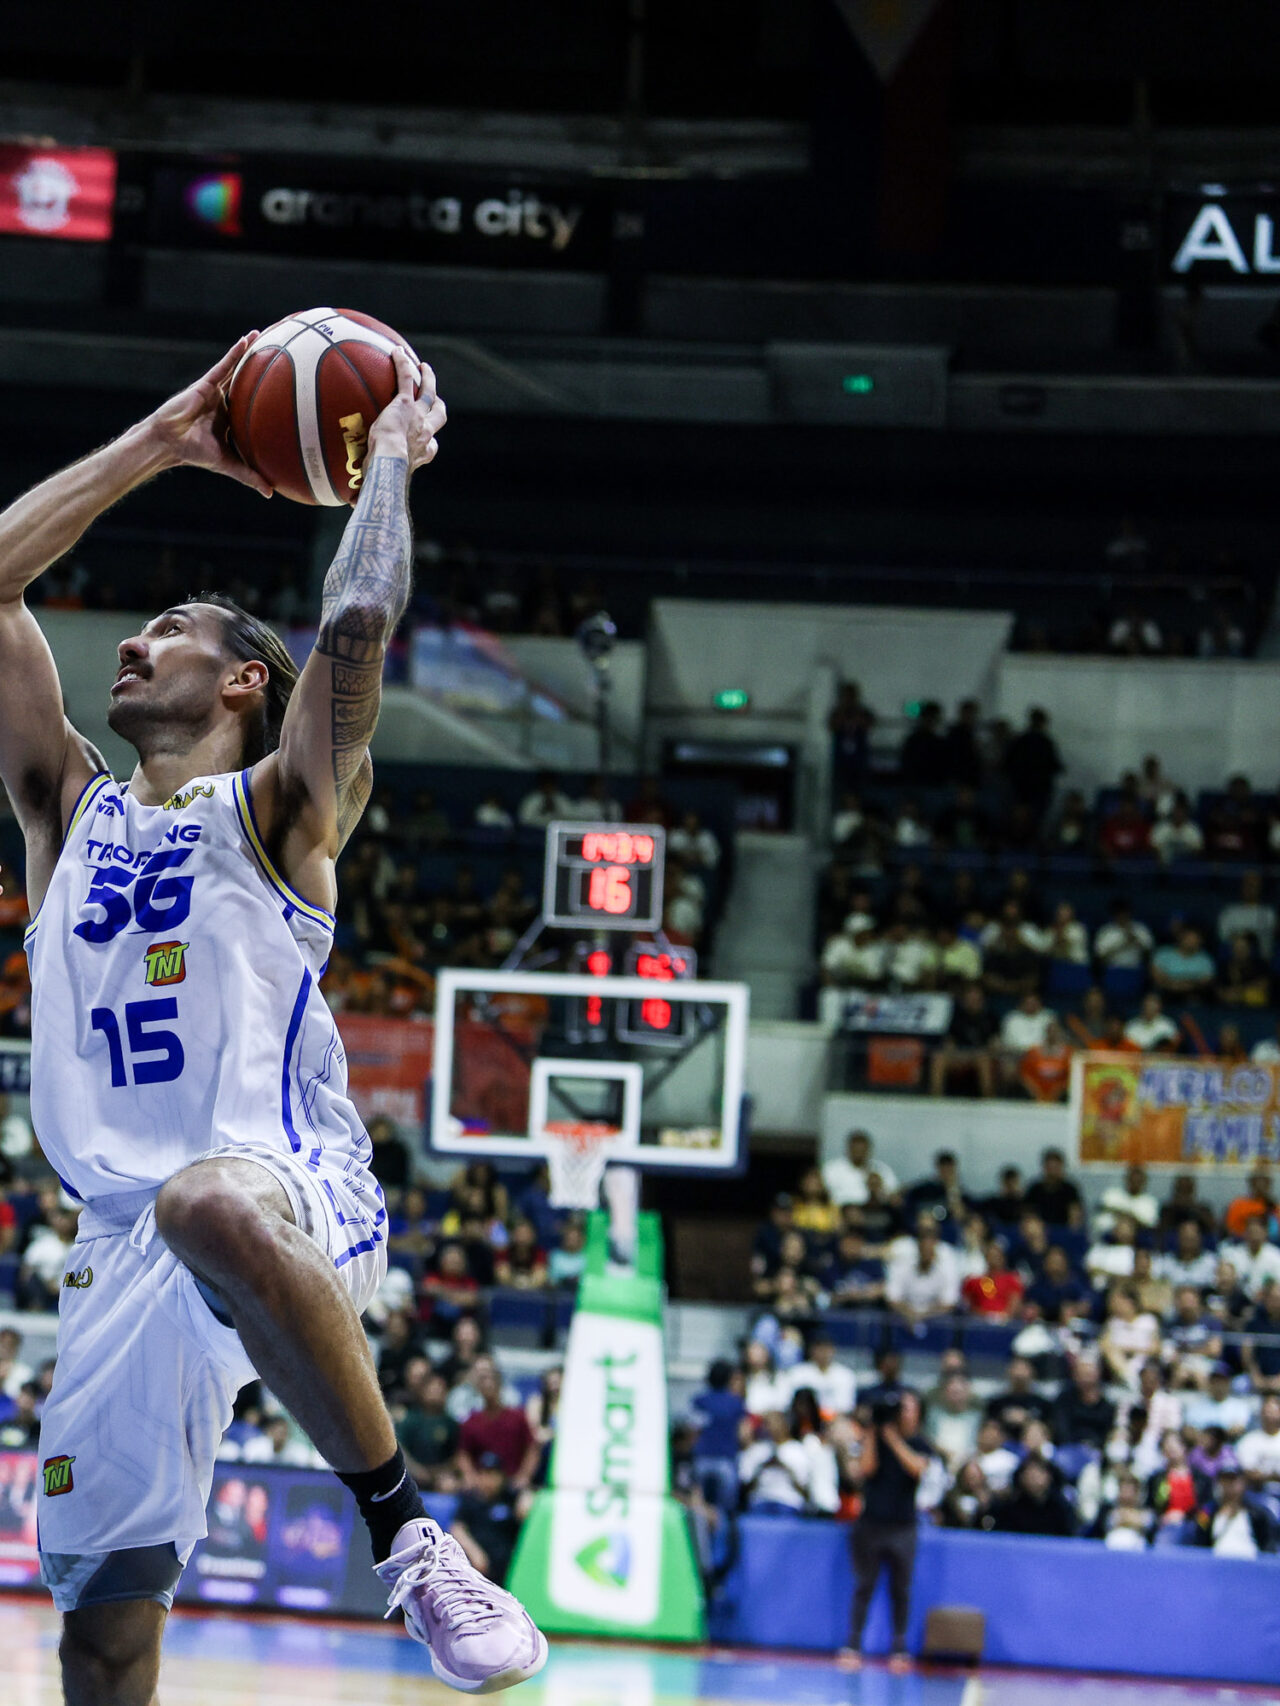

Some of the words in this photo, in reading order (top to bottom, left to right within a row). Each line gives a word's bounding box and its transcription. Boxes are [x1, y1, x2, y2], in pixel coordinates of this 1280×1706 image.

[473, 189, 582, 252] city
[144, 942, 189, 984] TNT
[91, 996, 185, 1088] 15
[586, 1350, 638, 1518] Smart
[43, 1455, 77, 1496] TNT
